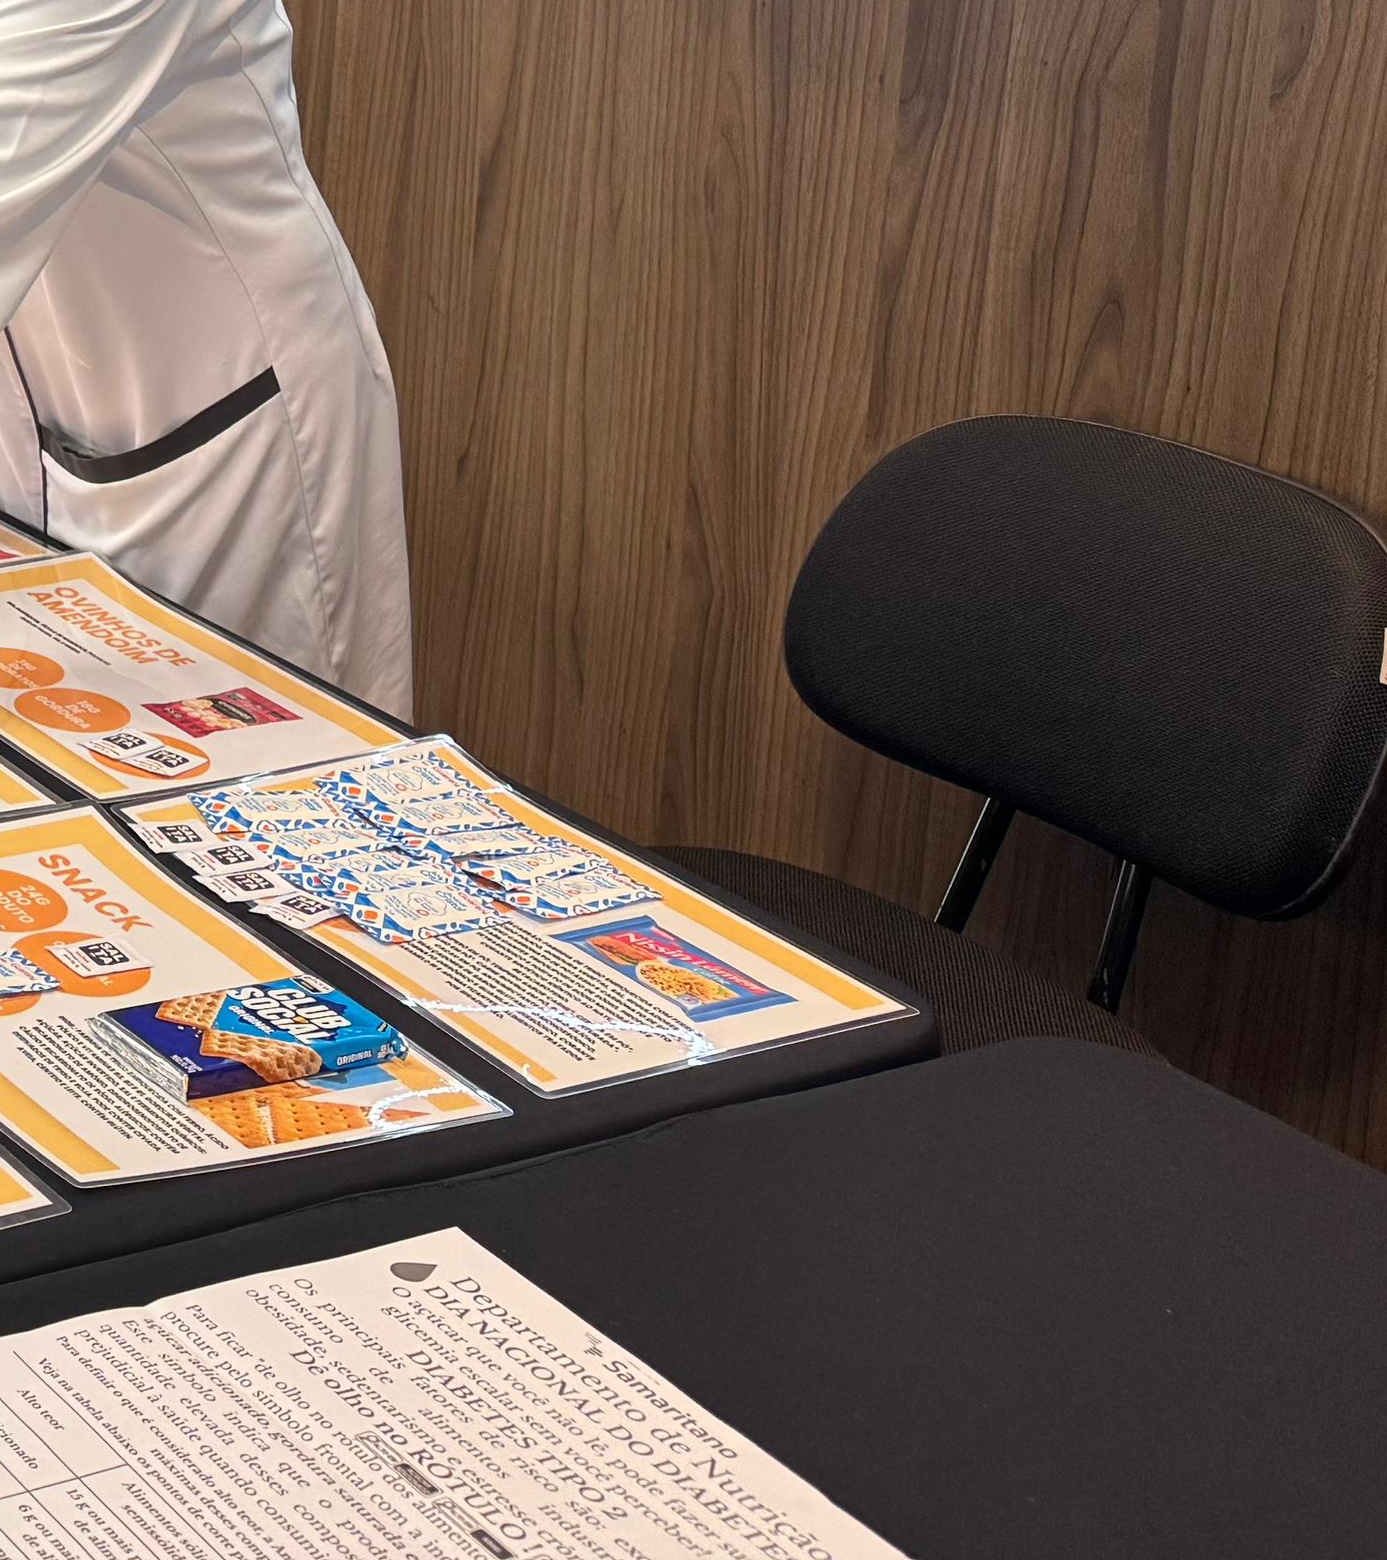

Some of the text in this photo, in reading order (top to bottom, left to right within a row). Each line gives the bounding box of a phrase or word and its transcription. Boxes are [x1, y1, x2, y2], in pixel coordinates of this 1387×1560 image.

[28, 592, 161, 665] AMENDOIM
[54, 586, 155, 650] OVINHOS
[154, 648, 196, 667] DE
[34, 695, 91, 730] GORDURA
[6, 889, 32, 906] DO
[23, 884, 51, 907] 24G
[38, 853, 154, 933] SNACK
[98, 941, 126, 962] SAL
[227, 986, 328, 1044] SOCIAL
[227, 1004, 273, 1035] ORIGINAL
[267, 987, 351, 1029] CLUB
[16, 1387, 42, 1414] Alto
[423, 1285, 795, 1560] DIA NACIONAL DO DIABETE
[450, 1276, 832, 1560] Departamento de Nutrição
[602, 1360, 738, 1459] Samaritano
[290, 1350, 527, 1541] Dê olho no RÓTULO
[405, 1349, 628, 1521] DIABETES TIPO 2
